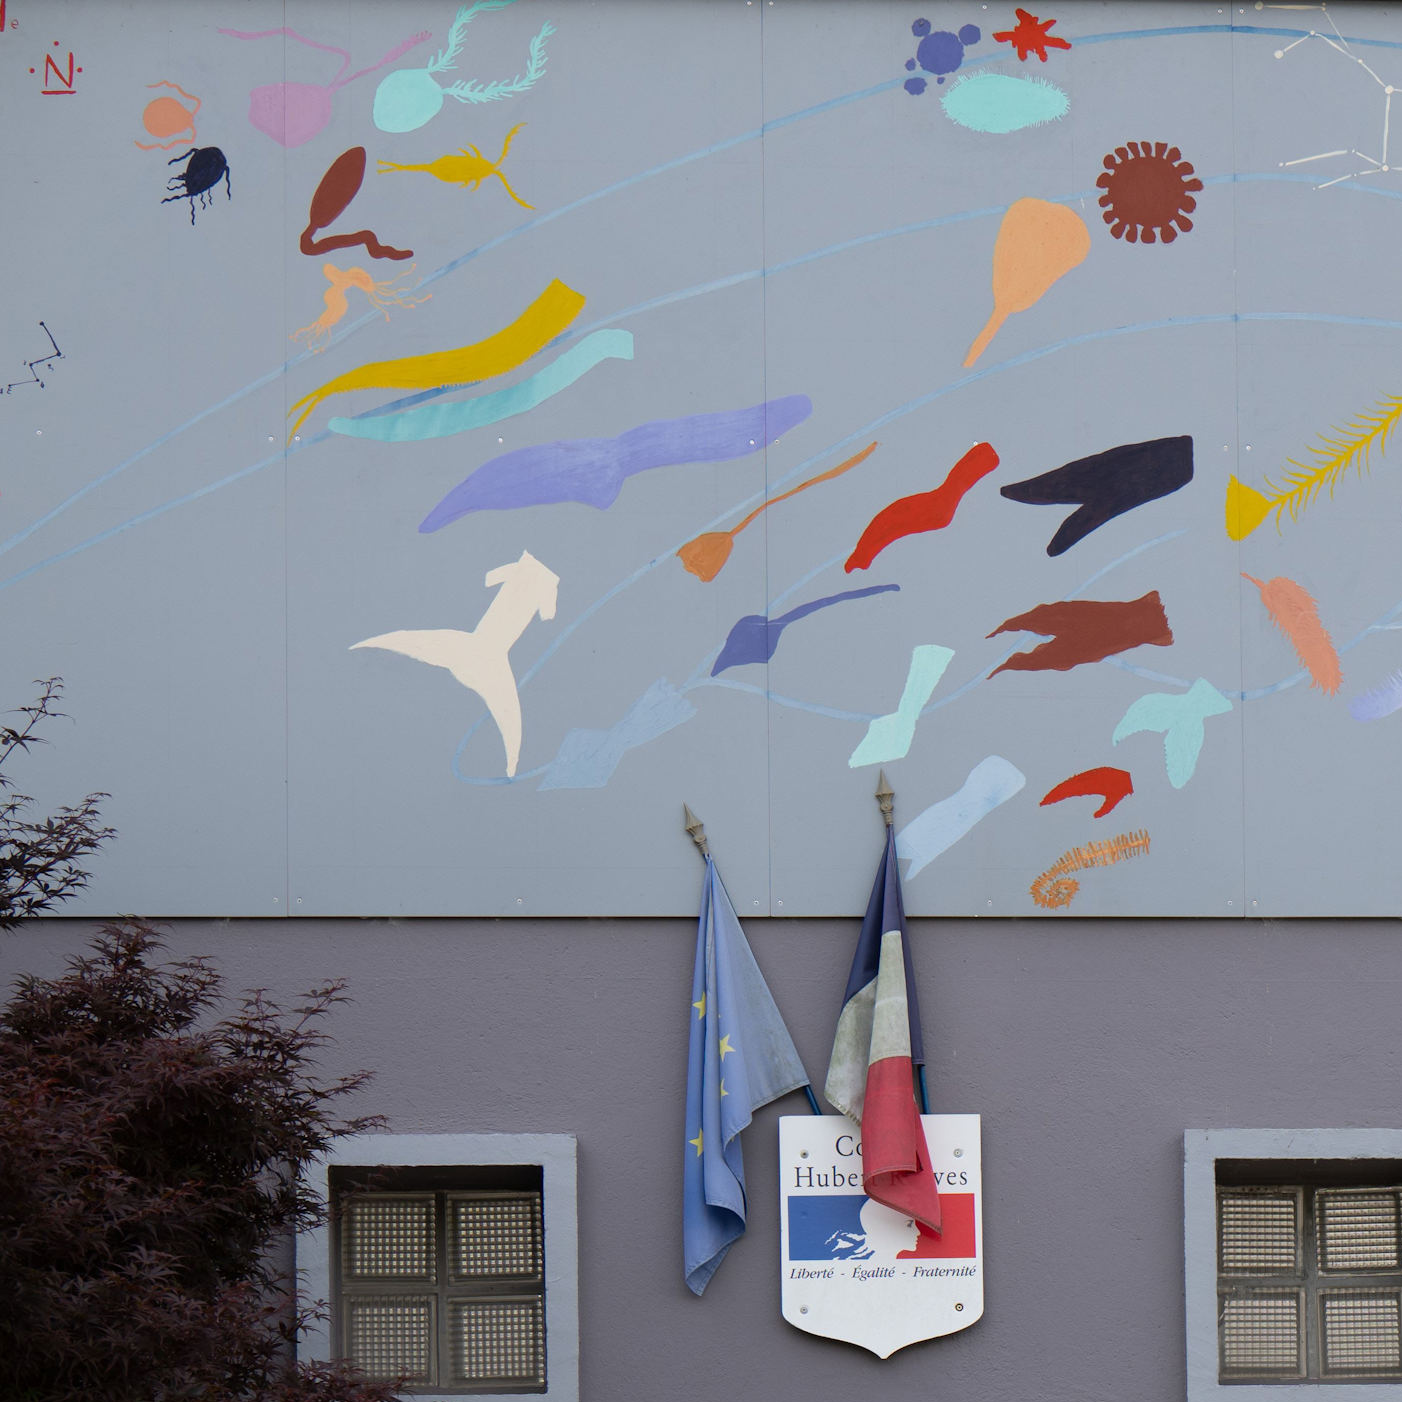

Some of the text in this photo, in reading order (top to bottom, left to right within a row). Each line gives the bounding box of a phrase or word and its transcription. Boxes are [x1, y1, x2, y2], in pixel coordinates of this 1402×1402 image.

[790, 1267, 834, 1280] Liberté
[852, 1264, 896, 1282] Égalité
[913, 1265, 977, 1279] Fraternité
